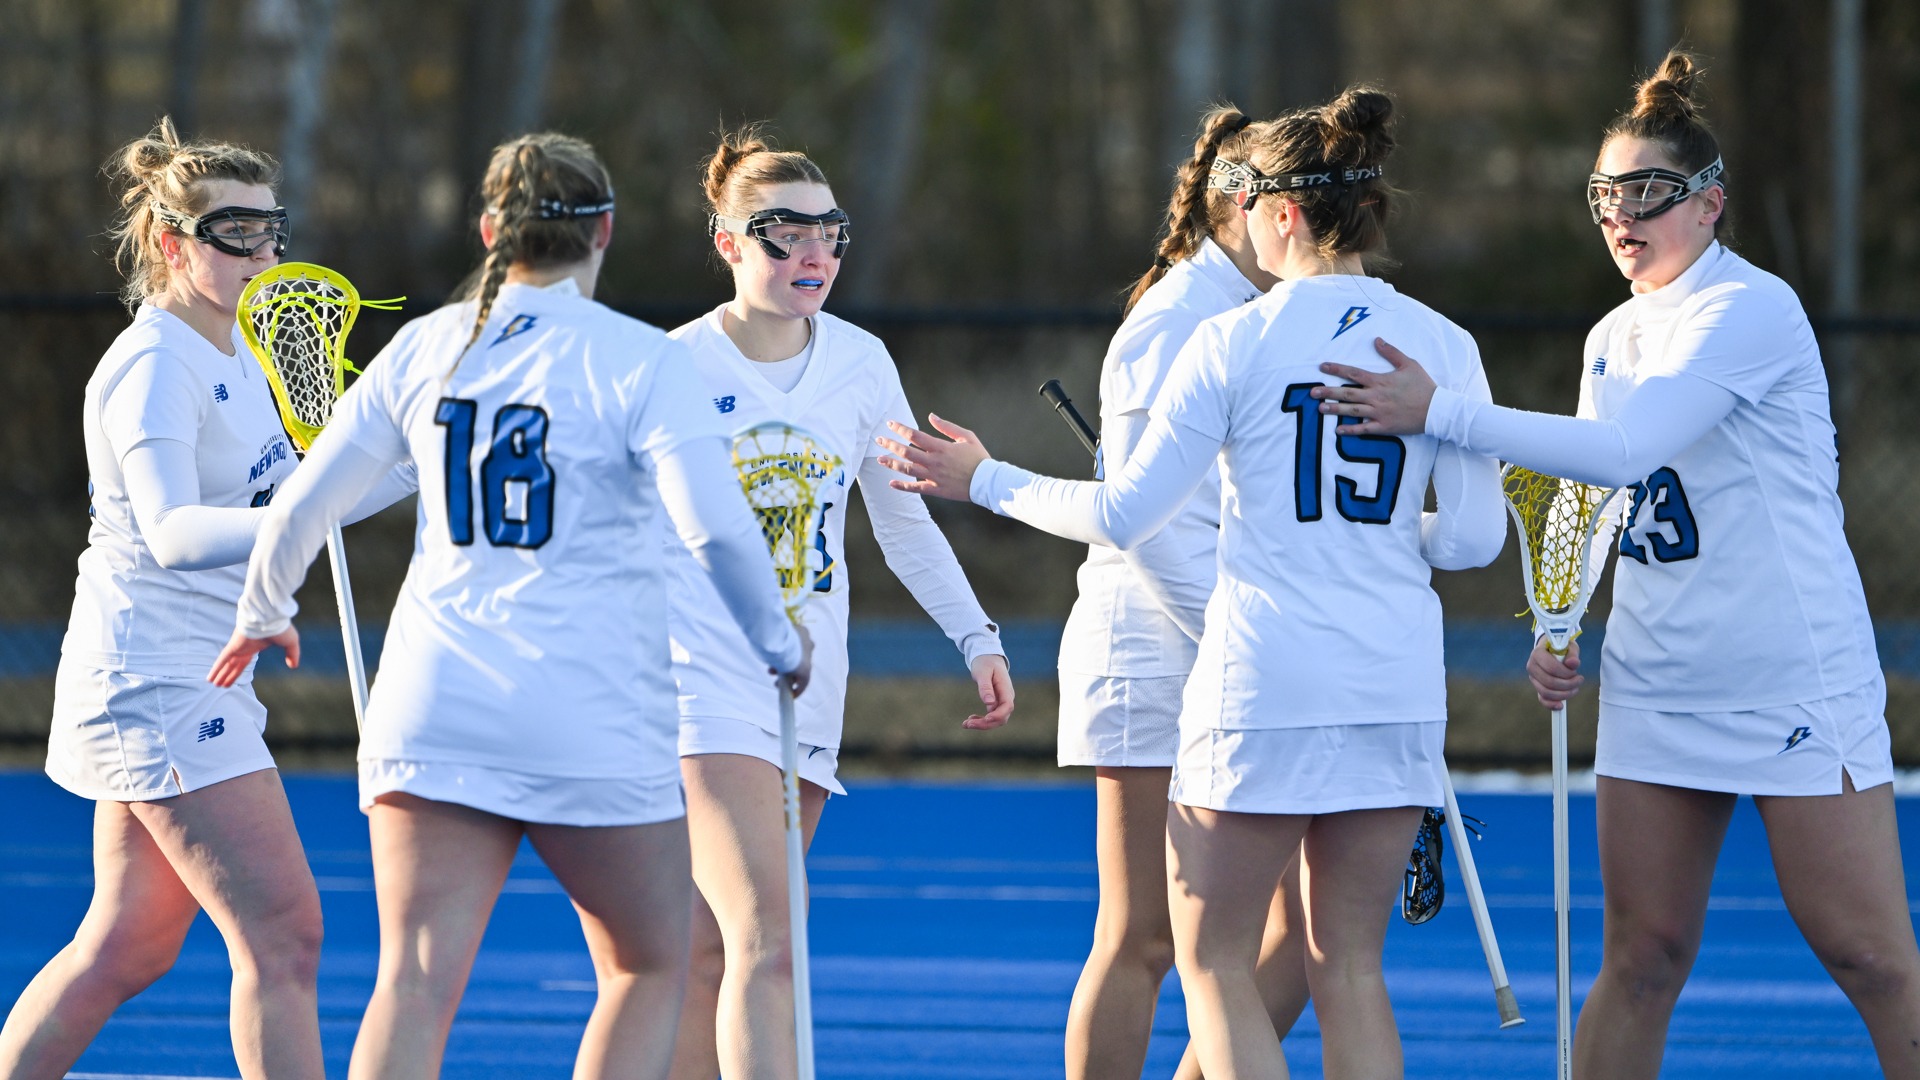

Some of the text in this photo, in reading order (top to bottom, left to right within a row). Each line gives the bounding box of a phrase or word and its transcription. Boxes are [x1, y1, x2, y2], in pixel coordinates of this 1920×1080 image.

[1290, 172, 1332, 188] STX
[1700, 161, 1720, 184] STX
[248, 448, 272, 484] NEW
[434, 397, 556, 551] 18
[1281, 382, 1407, 525] 15
[1620, 466, 1699, 565] 23
